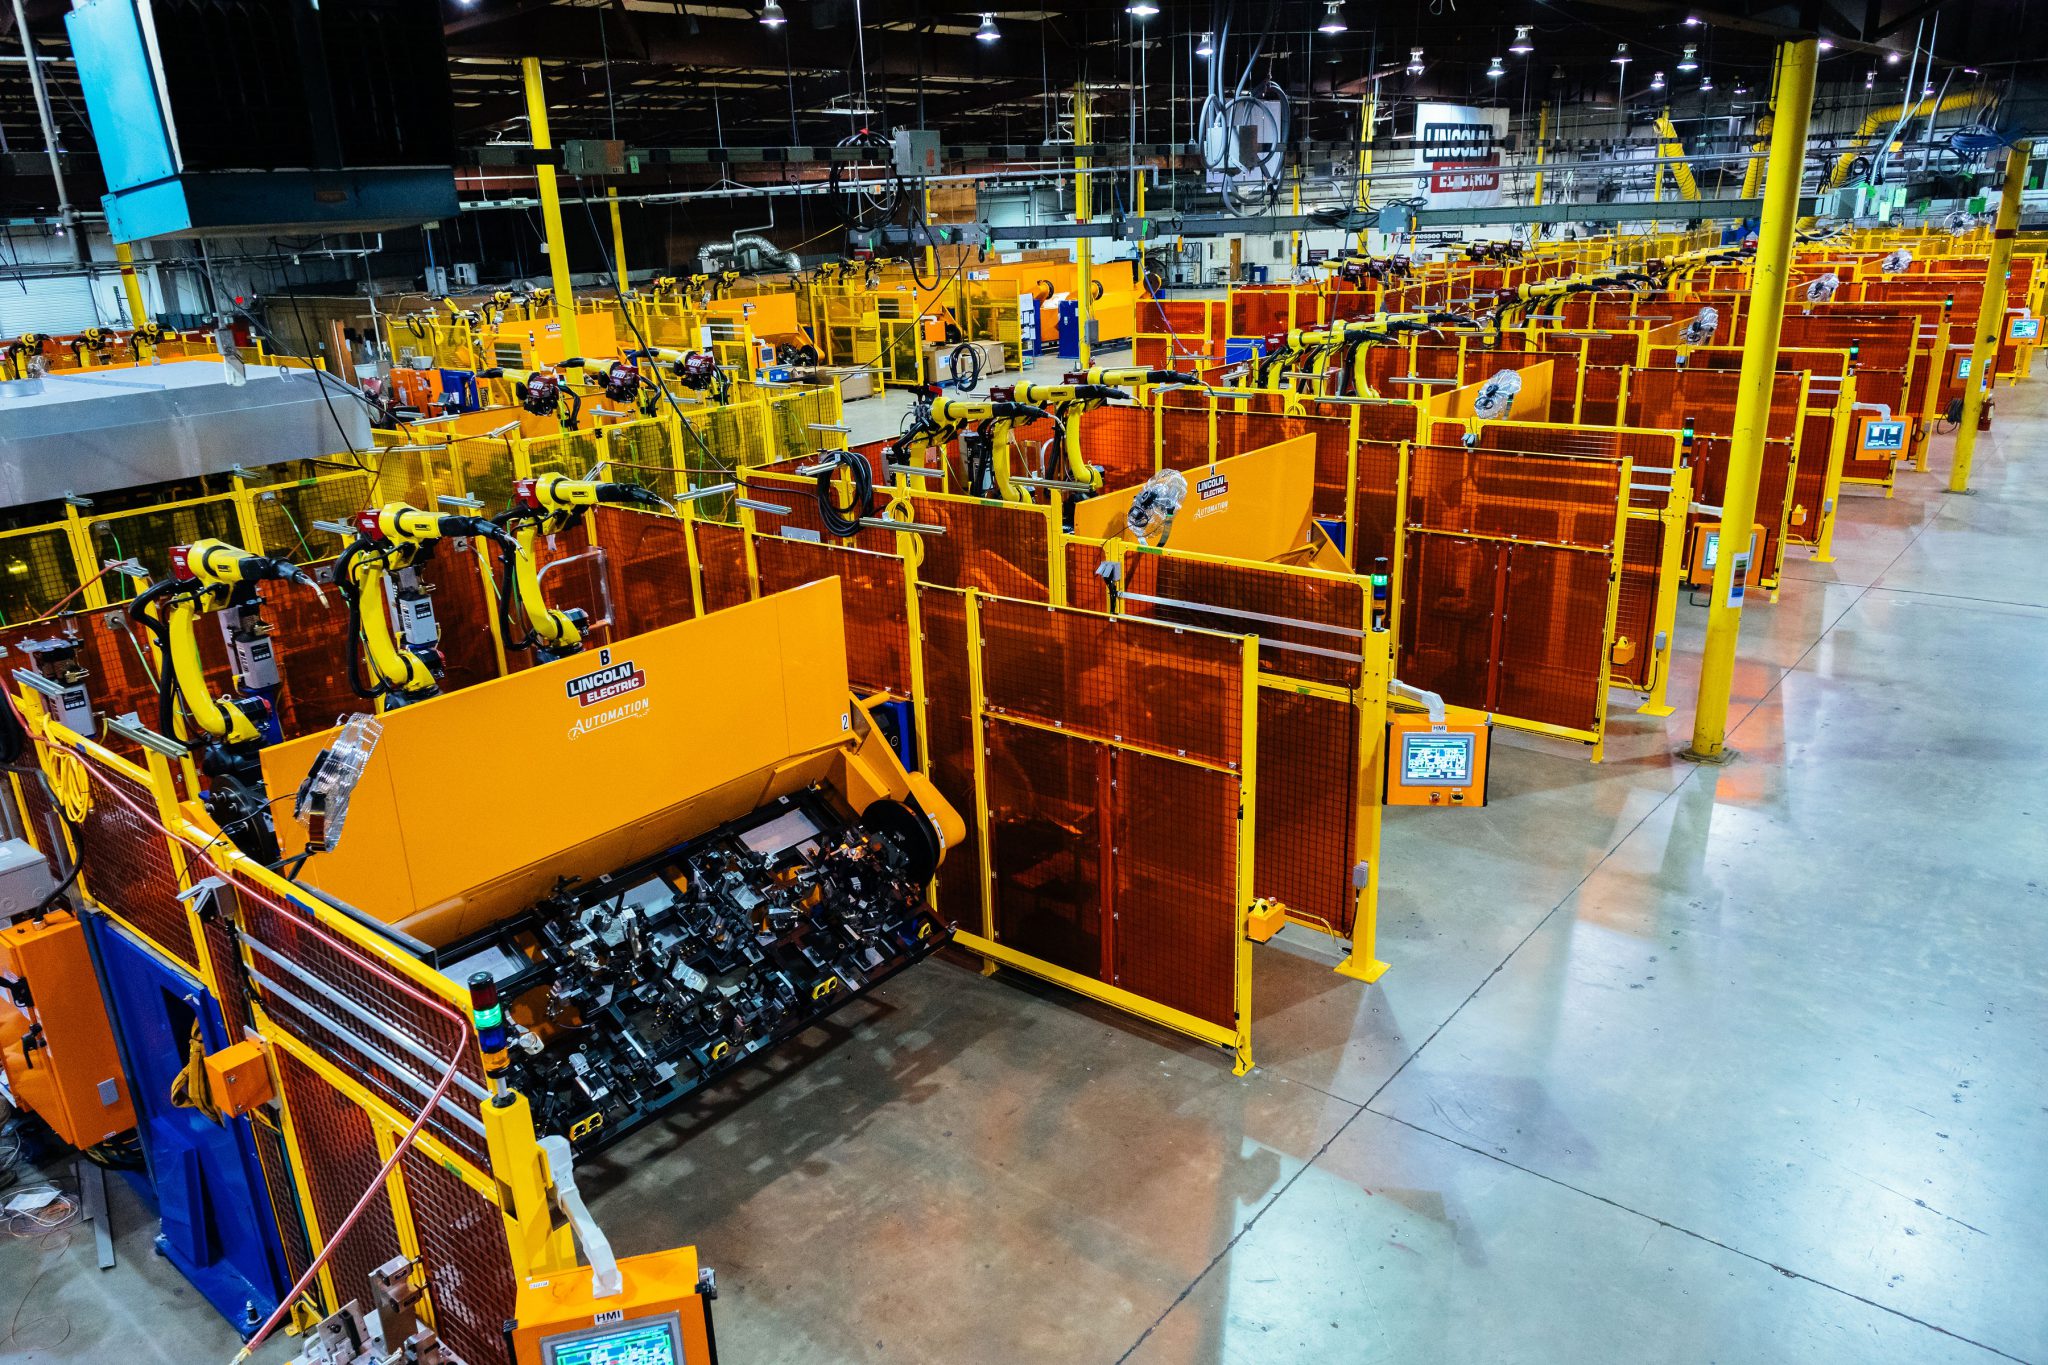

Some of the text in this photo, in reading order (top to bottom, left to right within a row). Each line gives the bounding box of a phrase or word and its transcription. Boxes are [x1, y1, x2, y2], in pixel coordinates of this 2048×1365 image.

[1425, 128, 1490, 158] LINCOLN
[1198, 476, 1224, 492] LINCOLN
[600, 649, 610, 666] B
[570, 664, 631, 695] LINCOLN
[586, 677, 640, 703] ELECTRIC
[572, 697, 649, 738] AUTOMATION
[842, 714, 849, 730] 2
[596, 1310, 621, 1322] HMI
